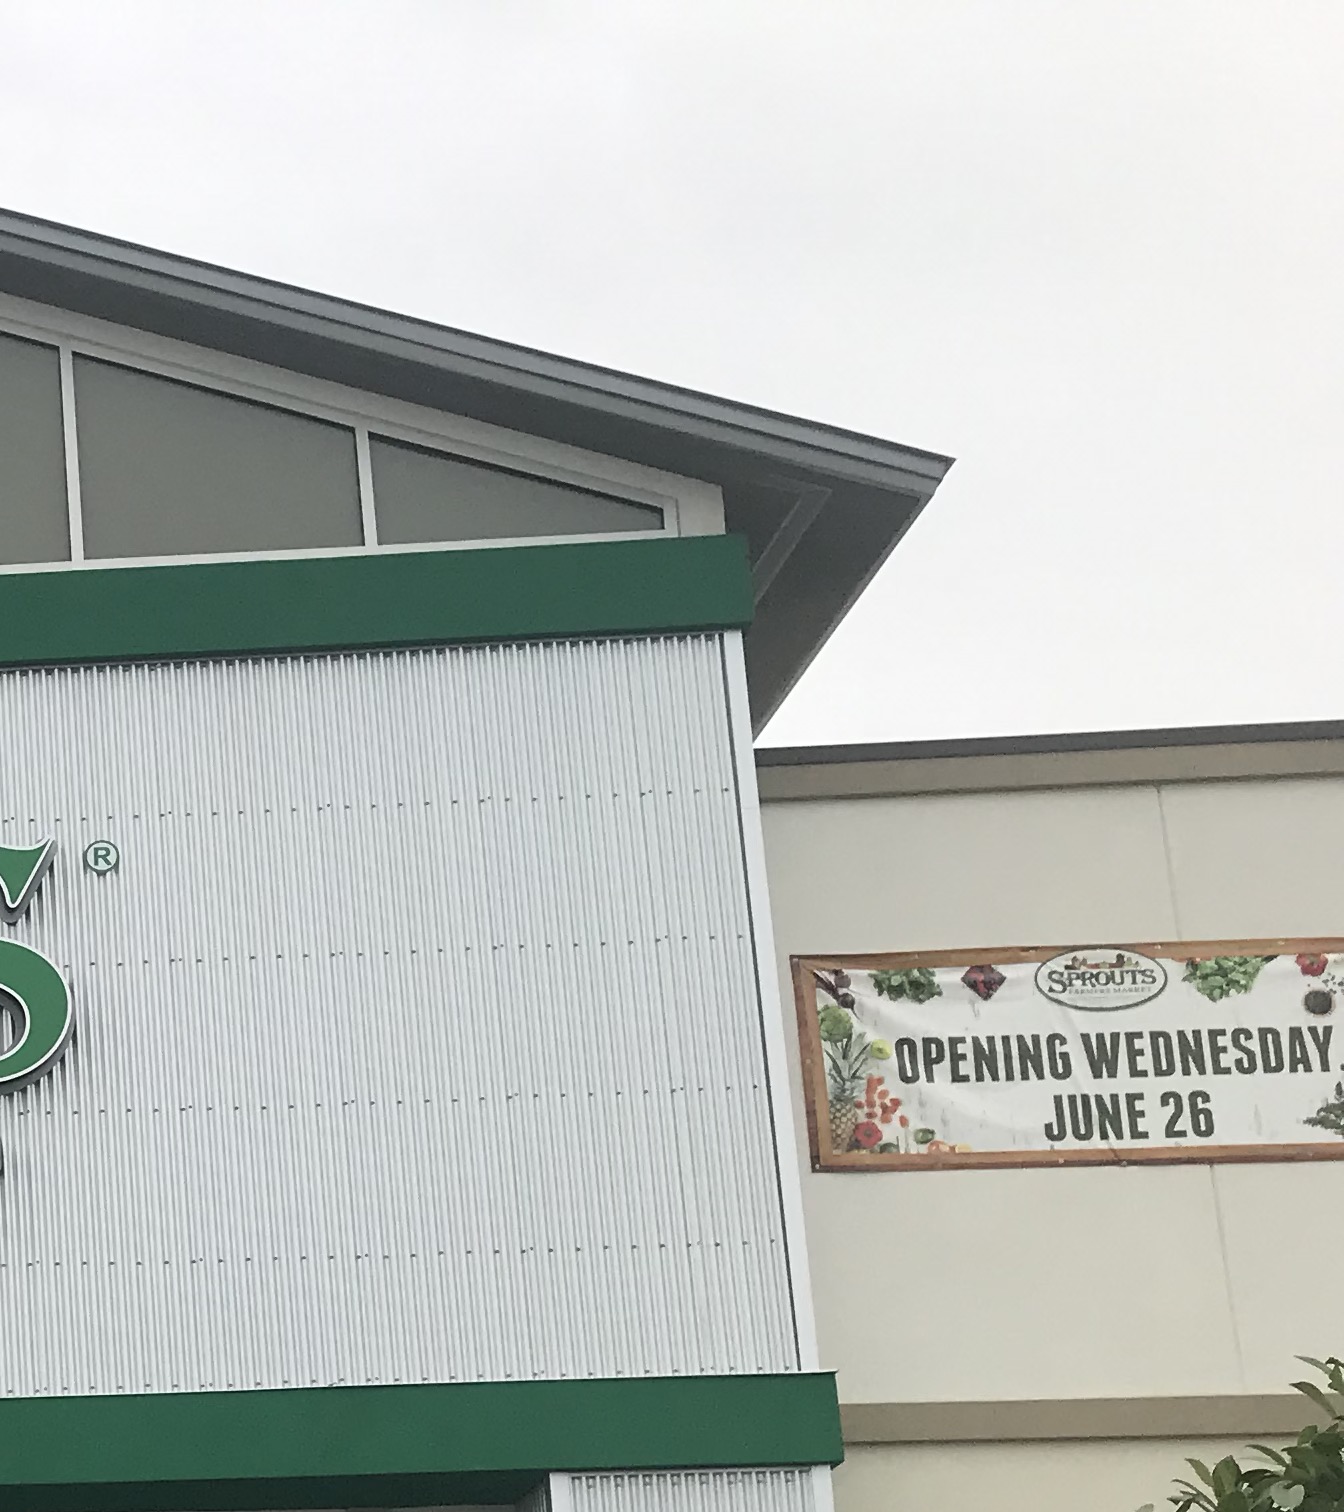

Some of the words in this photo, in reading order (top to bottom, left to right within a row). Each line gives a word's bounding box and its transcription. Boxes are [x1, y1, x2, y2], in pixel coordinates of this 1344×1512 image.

[1047, 968, 1157, 994] SPROUTS
[894, 1031, 1072, 1085] OPENING
[1080, 1025, 1333, 1081] WEDNESDAY
[1044, 1092, 1149, 1142] JUNE
[1159, 1090, 1215, 1139] 26
